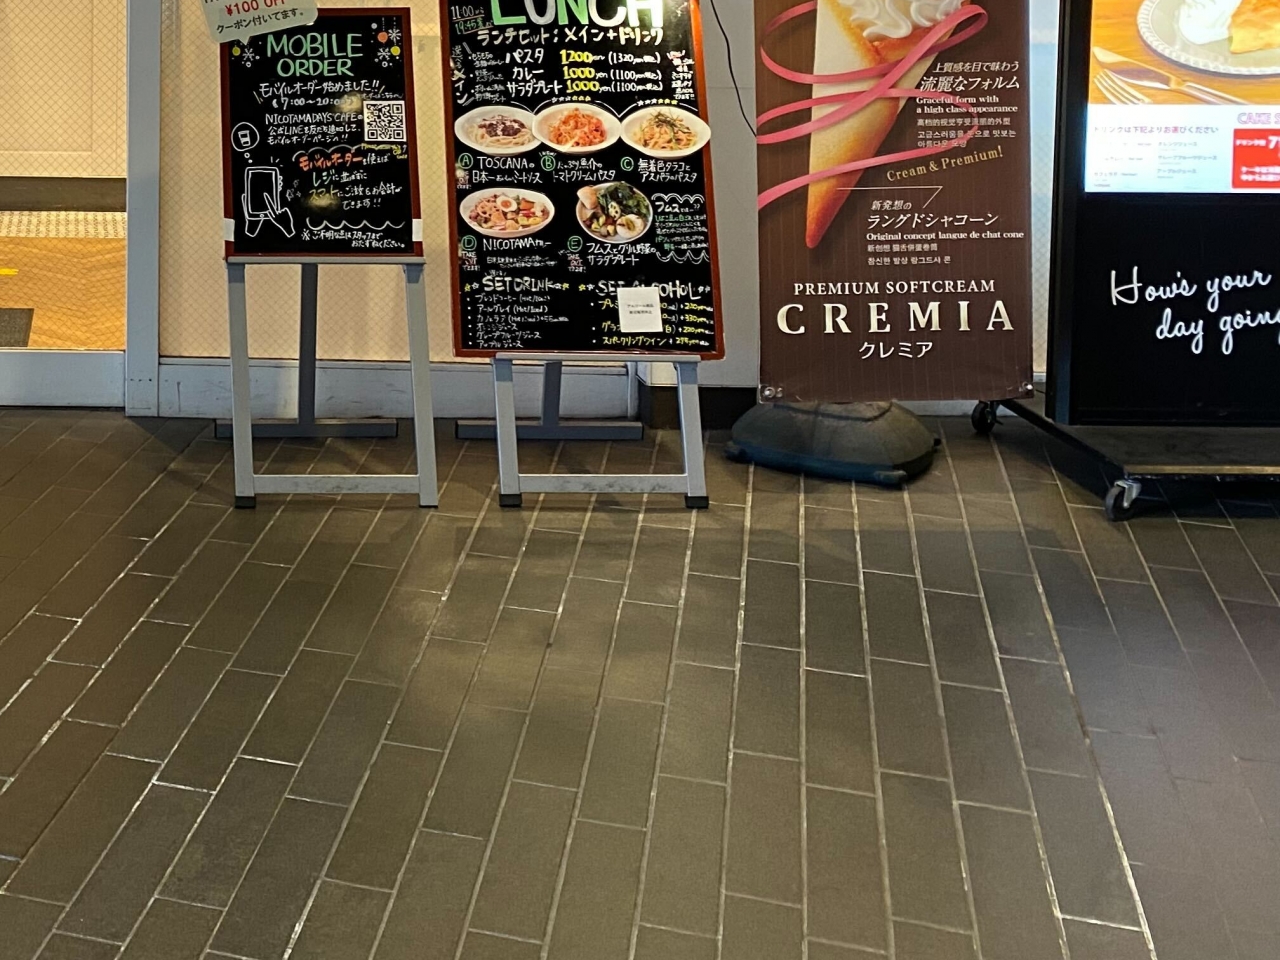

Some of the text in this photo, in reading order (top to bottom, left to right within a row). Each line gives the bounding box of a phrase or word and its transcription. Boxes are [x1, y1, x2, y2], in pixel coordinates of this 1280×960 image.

[216, 8, 304, 34] クーポン付いてます。
[266, 32, 363, 58] MOBILE
[505, 48, 544, 64] パスタ
[276, 58, 355, 77] ORDER
[512, 66, 545, 80] カレー
[932, 61, 1020, 73] 上質感を目で味わう
[506, 78, 564, 98] サラダプレート
[920, 75, 1020, 92] 流麗なフォルム
[916, 95, 999, 105] Graceful form with
[924, 105, 944, 114] high
[945, 105, 967, 113] class
[968, 106, 1018, 115] appearance
[992, 129, 1016, 138] 맛보는
[637, 157, 691, 172] 無着色タラコと
[886, 145, 1003, 181] Cream & Premium!
[552, 170, 616, 183] トマトクリームパスタ
[870, 200, 912, 211] 新発想の
[867, 213, 999, 229] ラングドシャコーン
[866, 232, 901, 241] Original
[904, 232, 936, 241] concept
[938, 231, 967, 240] langue
[982, 230, 1001, 238] chat
[587, 254, 639, 266] サラダプレート
[482, 275, 512, 292] SET
[794, 280, 995, 296] PREMIUM SOFTCREAM
[1110, 266, 1272, 313] How's your
[776, 299, 1014, 335] CREMIA
[1156, 307, 1205, 354] day
[858, 341, 933, 360] クレミア
